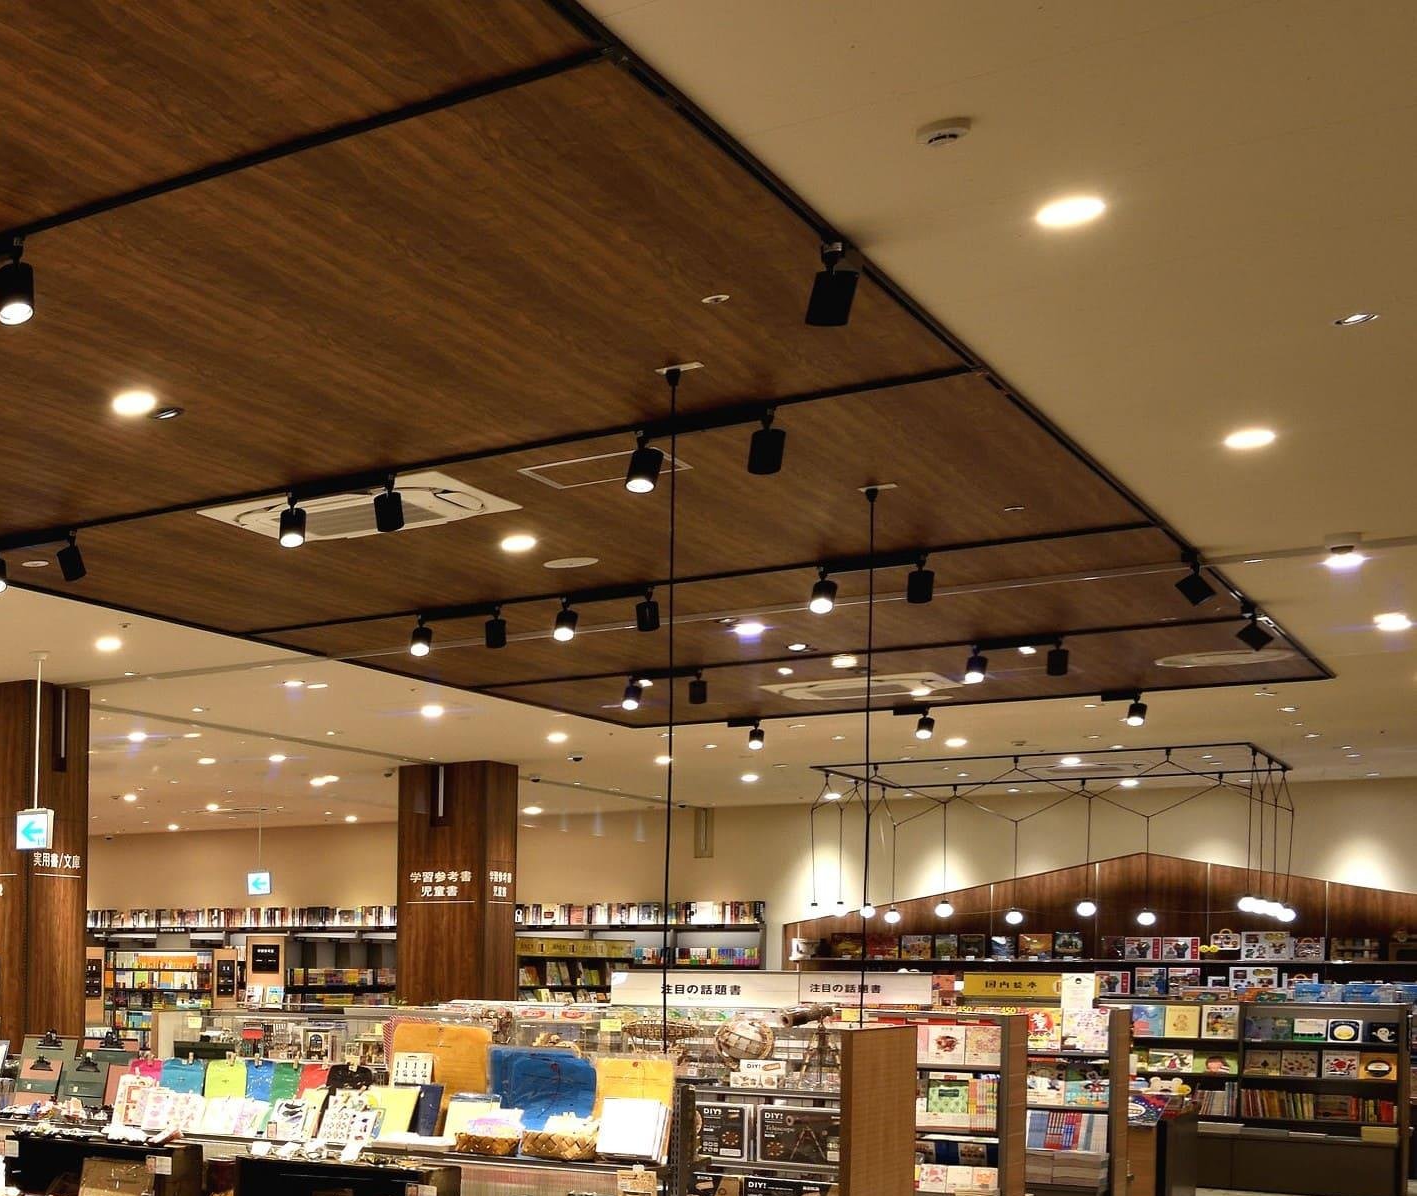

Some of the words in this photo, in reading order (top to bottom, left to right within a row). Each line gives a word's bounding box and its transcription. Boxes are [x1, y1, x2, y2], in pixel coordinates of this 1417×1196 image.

[33, 851, 81, 869] 実用書/文庫
[409, 870, 473, 884] 学習参考書
[420, 885, 459, 897] 児童書
[660, 983, 742, 996] 注目の話題書
[809, 983, 882, 994] 注目の話題書
[764, 1111, 783, 1119] DIY!
[748, 1181, 767, 1189] DIY!
